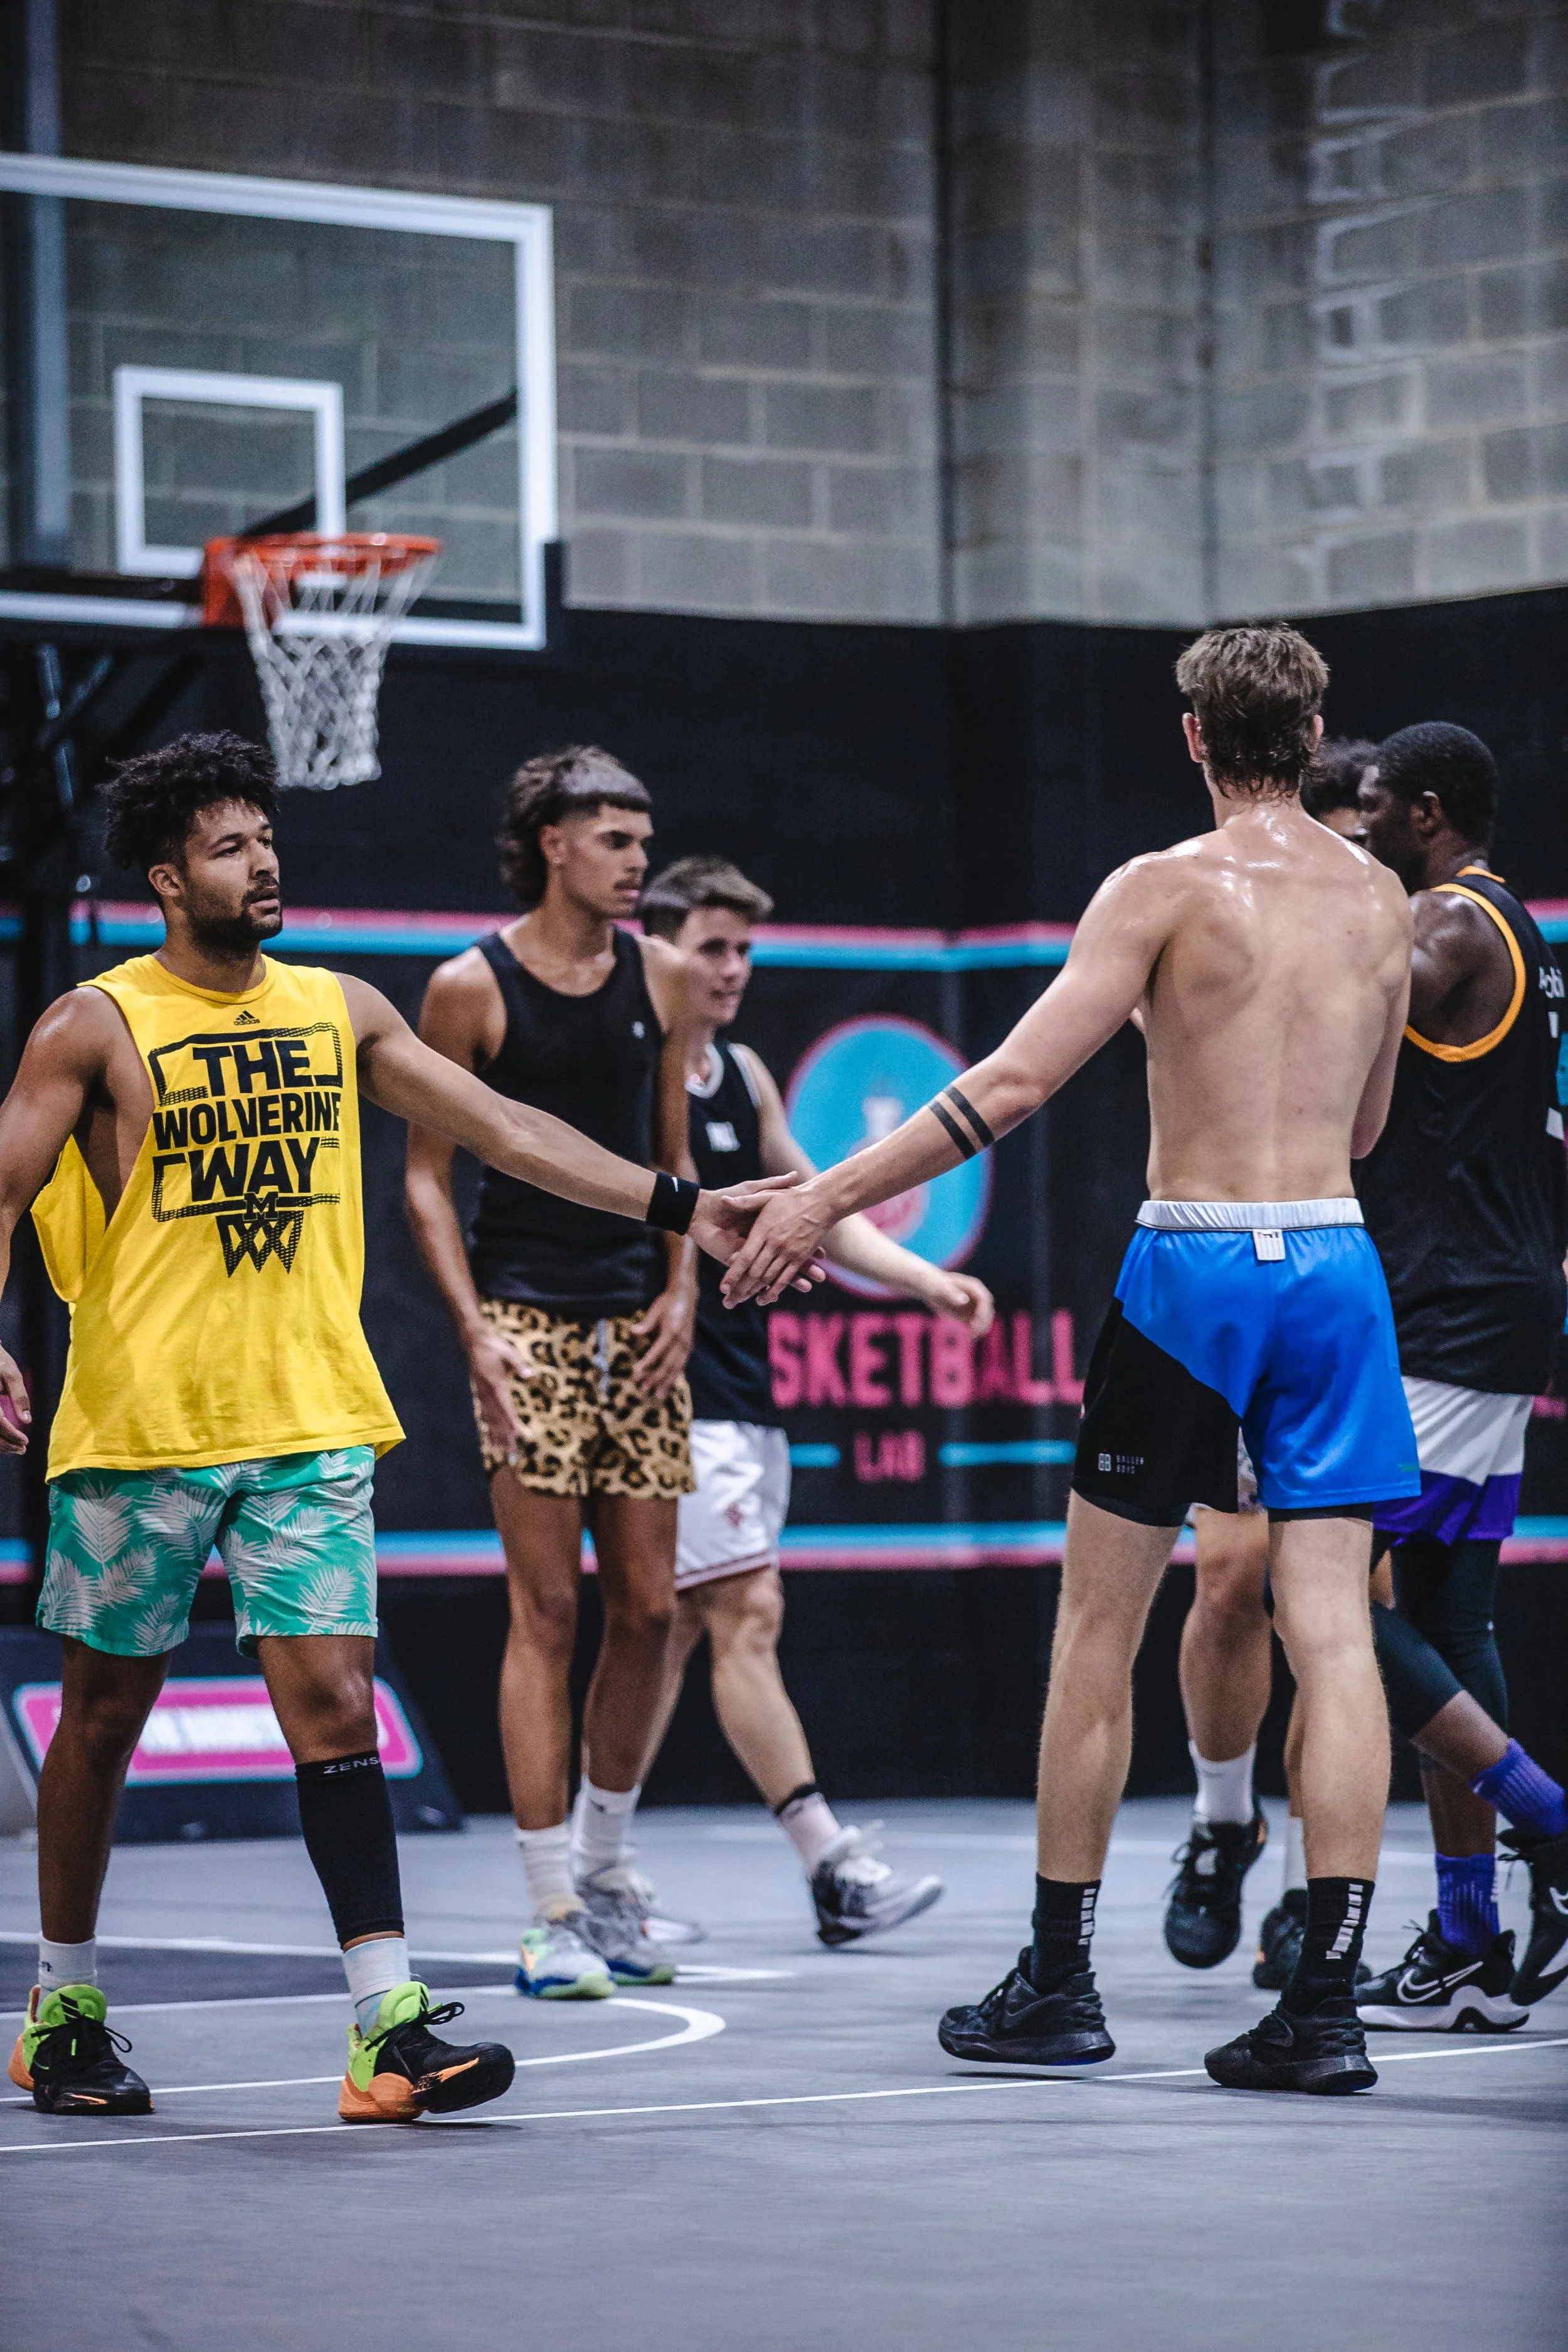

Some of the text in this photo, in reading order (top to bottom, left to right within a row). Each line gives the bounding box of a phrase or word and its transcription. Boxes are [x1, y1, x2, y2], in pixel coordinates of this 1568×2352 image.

[193, 1039, 314, 1097] THE
[152, 1091, 341, 1150] WOLVERINE
[188, 1136, 320, 1202] WAY
[323, 1756, 380, 1774] ZENS
